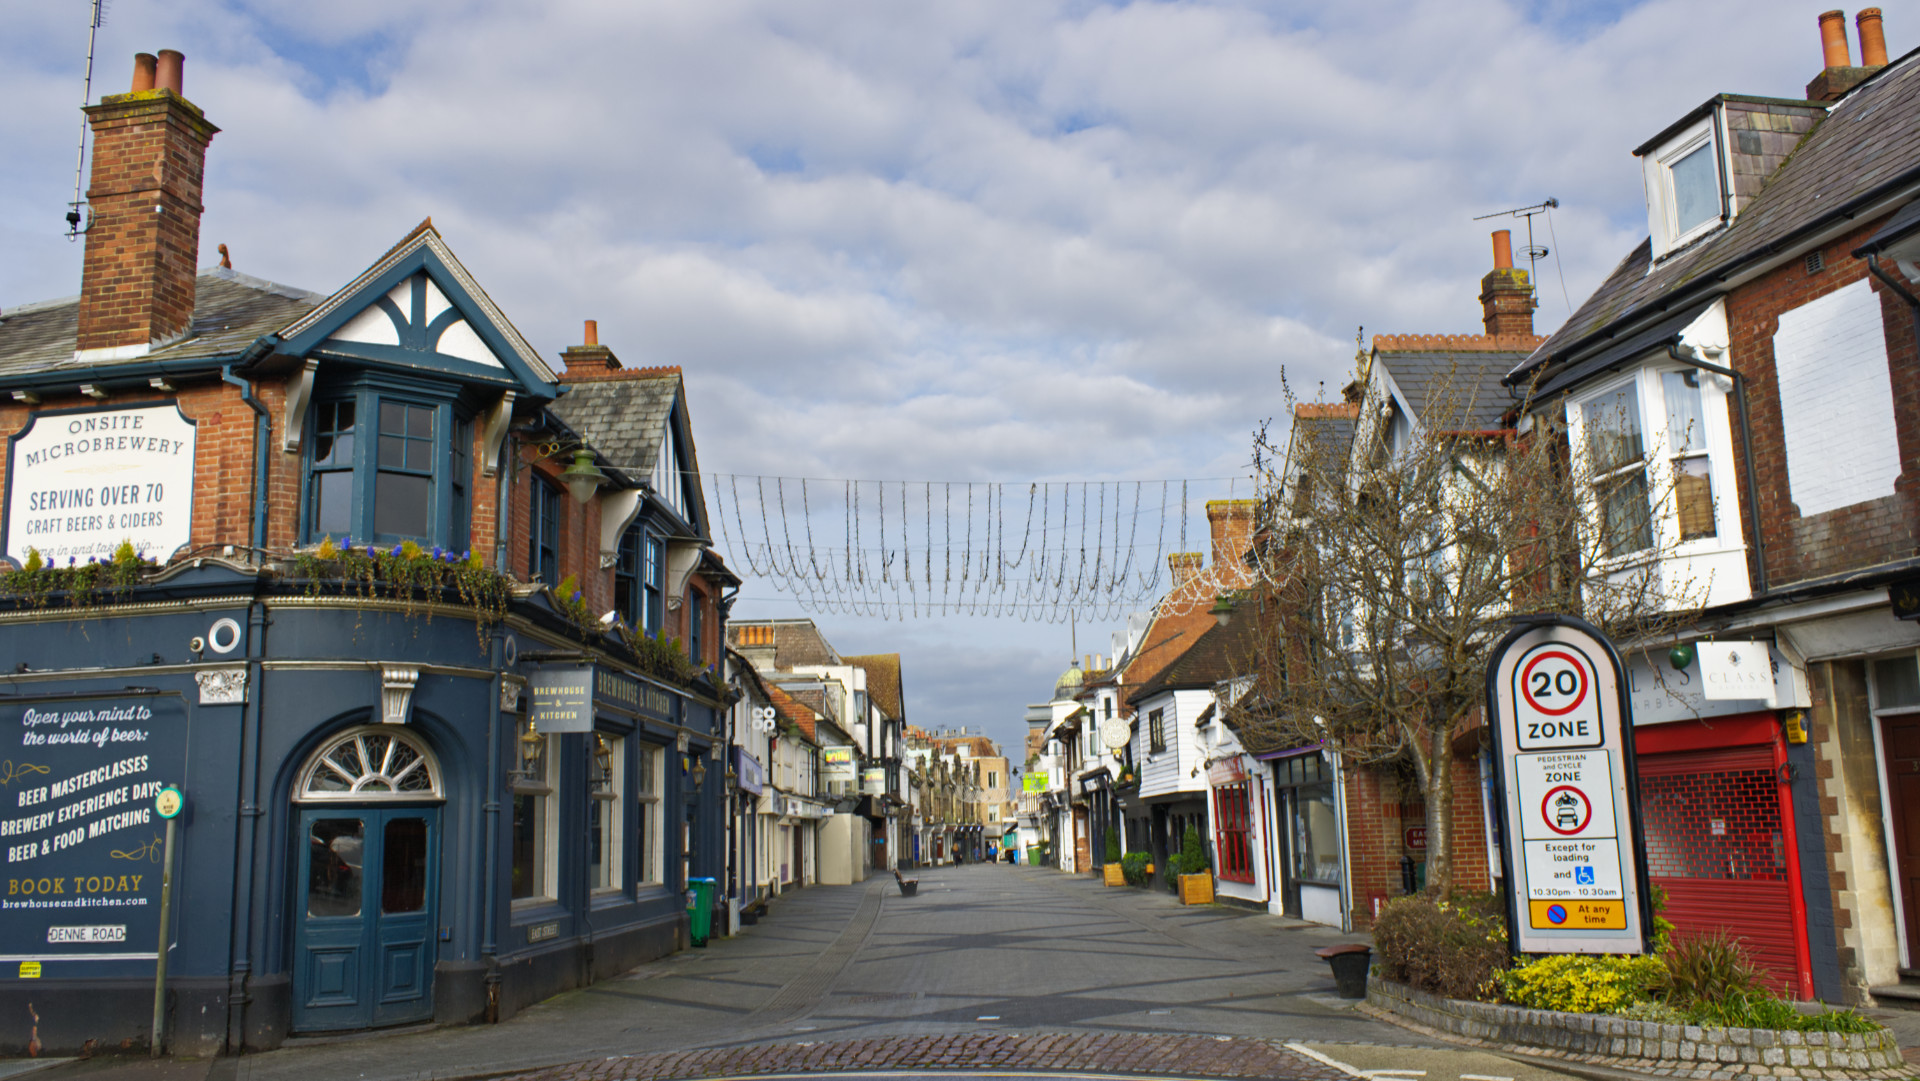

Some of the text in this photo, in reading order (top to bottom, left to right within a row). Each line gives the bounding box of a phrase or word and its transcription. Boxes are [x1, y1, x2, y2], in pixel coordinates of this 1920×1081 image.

[68, 415, 145, 435] ONSITE
[26, 436, 184, 468] MICROBREWERY
[29, 483, 164, 511] SERVING OVER 70
[26, 511, 163, 535] CRAFT BEERS & CIDERS
[22, 544, 53, 558] Cme
[71, 542, 95, 556] and
[1531, 670, 1577, 697] 20
[1708, 672, 1767, 683] CLASS
[533, 686, 585, 696] BREWHOUSE
[555, 699, 562, 708] &
[23, 705, 152, 728] Open your mind to
[540, 711, 578, 720] KITCHEN
[1528, 720, 1589, 739] ZONE
[23, 727, 149, 748] the world of beer:
[1537, 754, 1587, 763] PEDESTRIAN
[1557, 762, 1582, 770] CYCLE
[18, 755, 149, 807] BEER MASTERCLASSES
[1545, 771, 1581, 782] ZONE
[0, 781, 163, 837] BREWERY EXPERIENCE DAYS
[8, 842, 38, 863] BEER
[40, 839, 50, 856] &
[53, 827, 85, 852] FOOD
[88, 808, 150, 840] MATCHING
[1545, 843, 1596, 853] Except for
[1553, 853, 1589, 862] loading
[1554, 870, 1571, 879] and
[8, 875, 143, 895] BOOK TODAY
[1533, 888, 1571, 897] 10.30pm
[1578, 888, 1617, 896] 10.30am
[2, 897, 148, 909] brewhouseandkitchen.com
[1578, 905, 1610, 915] At any
[1584, 915, 1606, 924] time
[51, 927, 123, 941] DENNE ROAD
